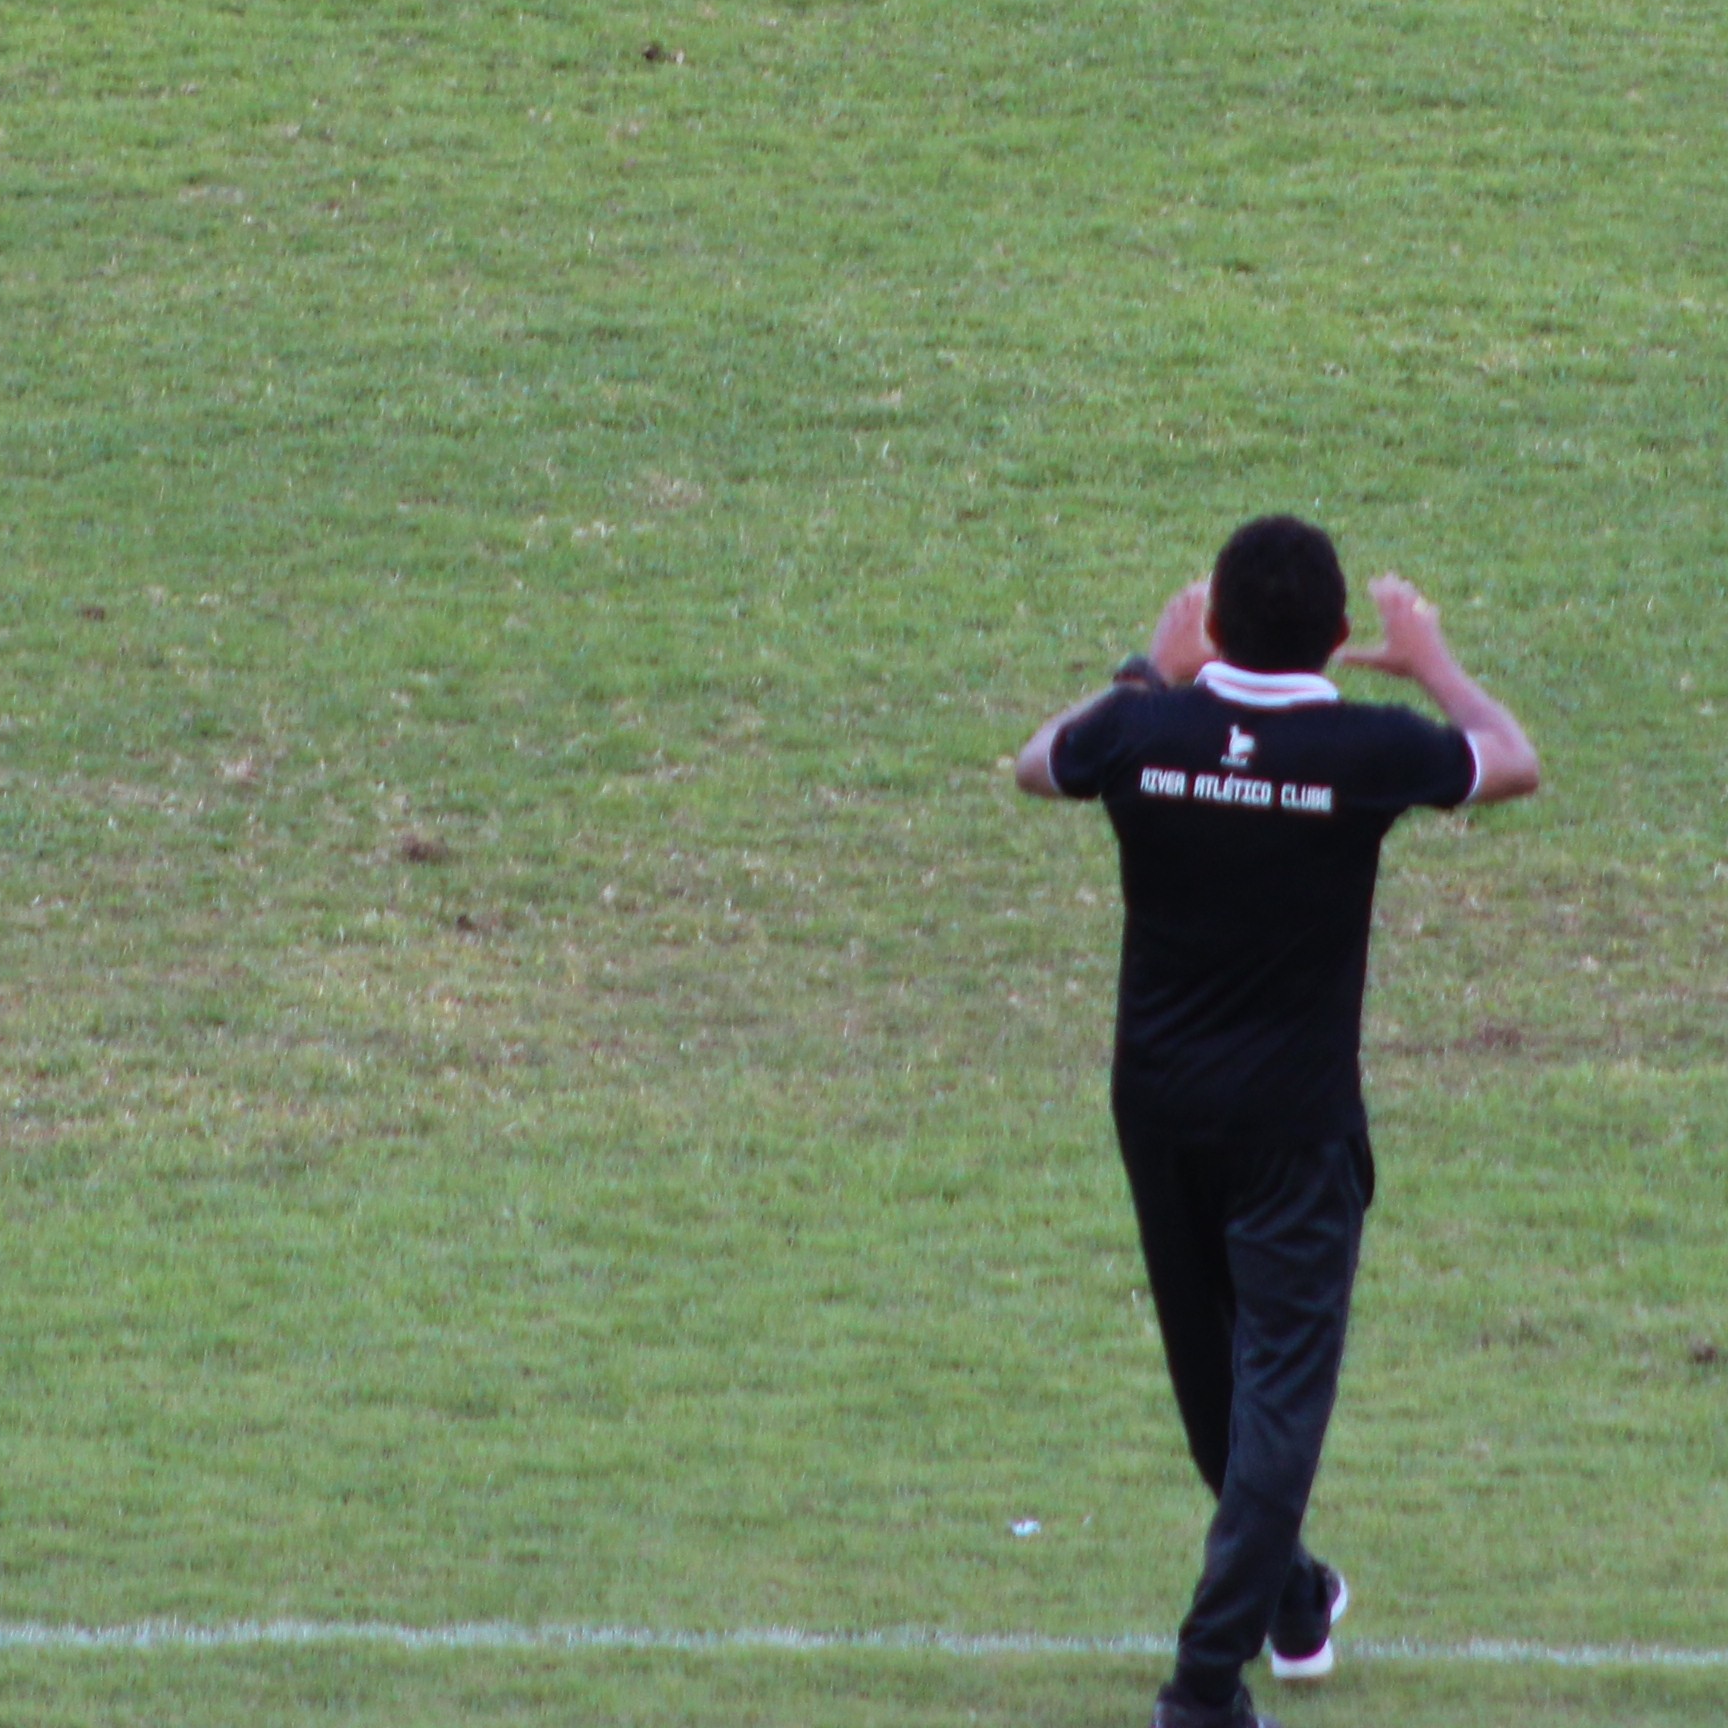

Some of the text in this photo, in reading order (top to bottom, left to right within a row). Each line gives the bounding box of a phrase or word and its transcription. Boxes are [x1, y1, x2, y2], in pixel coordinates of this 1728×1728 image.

[1140, 767, 1333, 813] RIVER ATLÉTICO CLUBE
